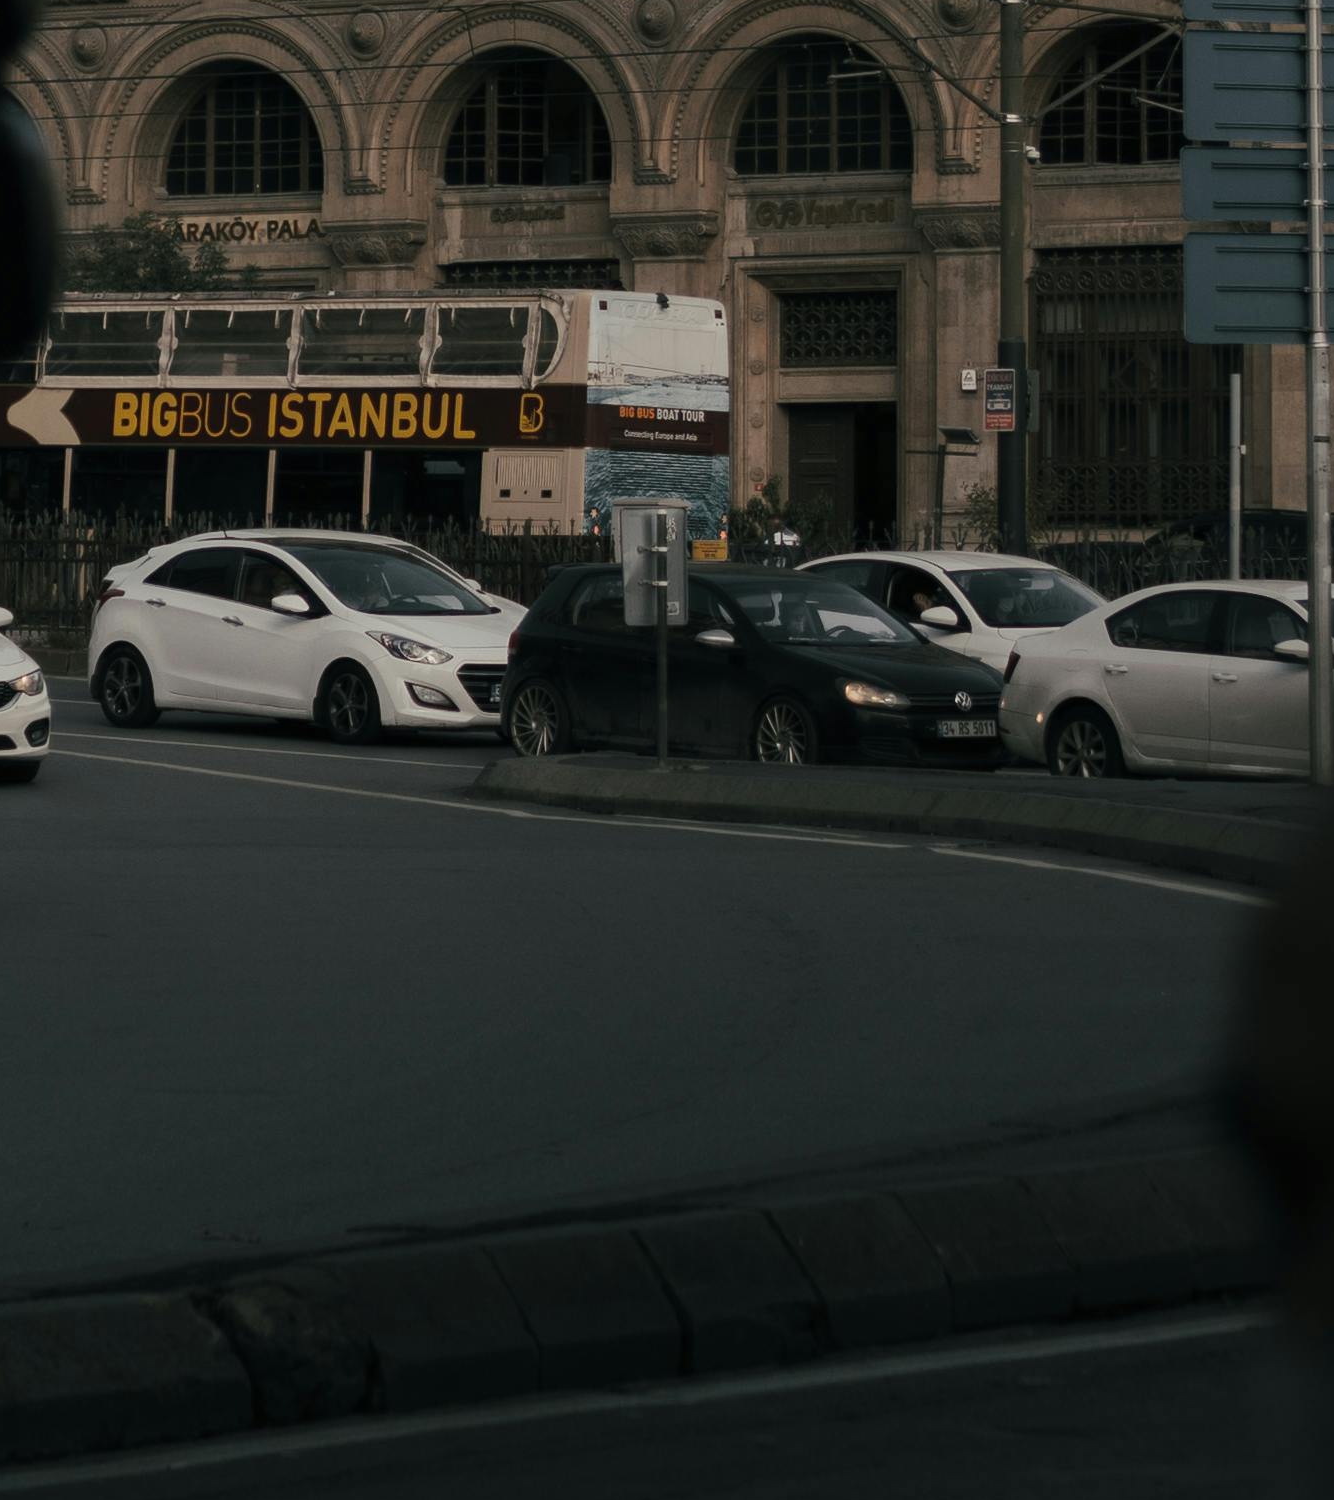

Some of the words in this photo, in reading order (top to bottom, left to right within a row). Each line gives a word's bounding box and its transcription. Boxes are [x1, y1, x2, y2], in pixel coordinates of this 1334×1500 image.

[163, 217, 259, 243] ARAKÖY
[268, 392, 476, 440] ISTANBUL
[619, 406, 635, 418] BIG
[637, 407, 655, 419] BUS
[656, 408, 679, 421] BOAT
[681, 409, 705, 422] TOUR
[624, 429, 654, 441] Connecting
[655, 431, 674, 442] Europe
[685, 433, 698, 442] Asia
[943, 722, 955, 735] 34
[959, 722, 970, 735] RS
